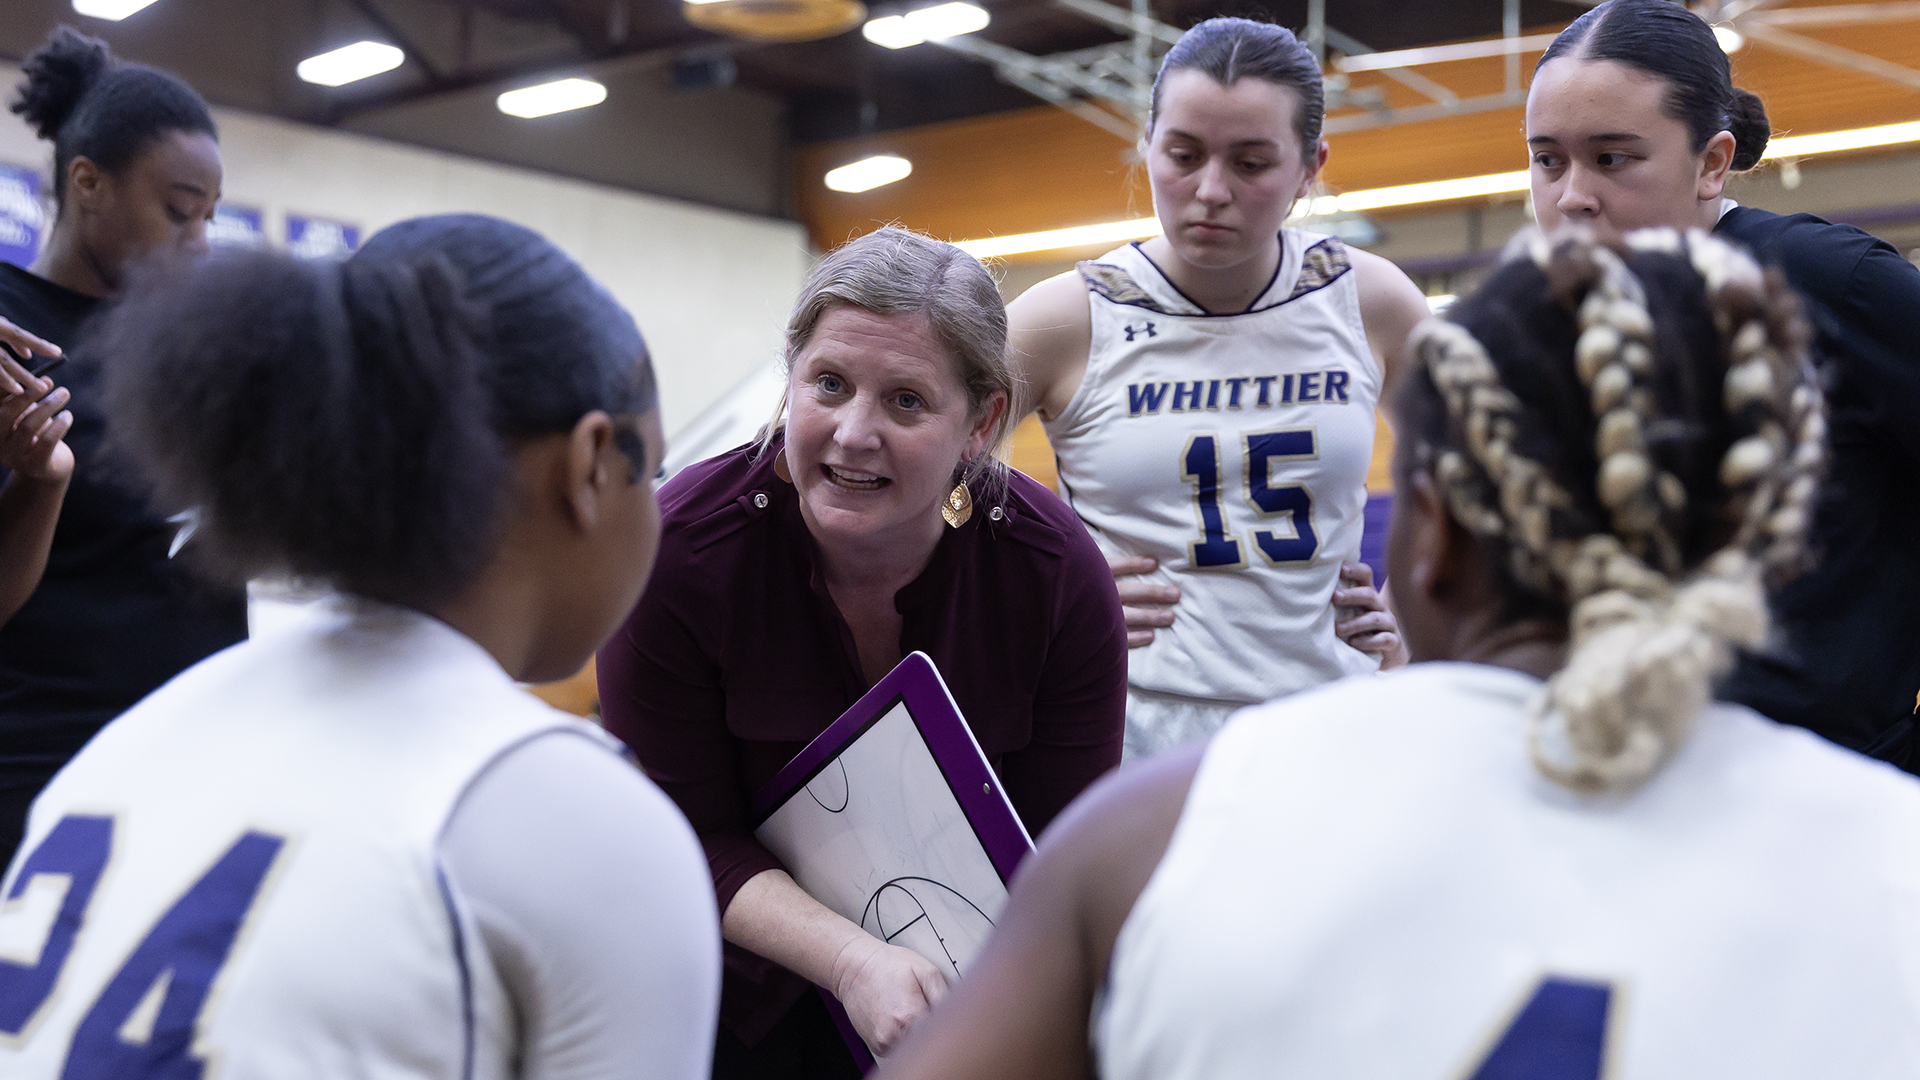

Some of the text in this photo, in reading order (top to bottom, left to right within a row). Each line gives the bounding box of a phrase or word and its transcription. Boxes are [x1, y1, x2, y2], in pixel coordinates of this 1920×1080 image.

[1126, 370, 1350, 418] WHITTIER
[1179, 425, 1322, 570] 15
[0, 812, 292, 1080] 24
